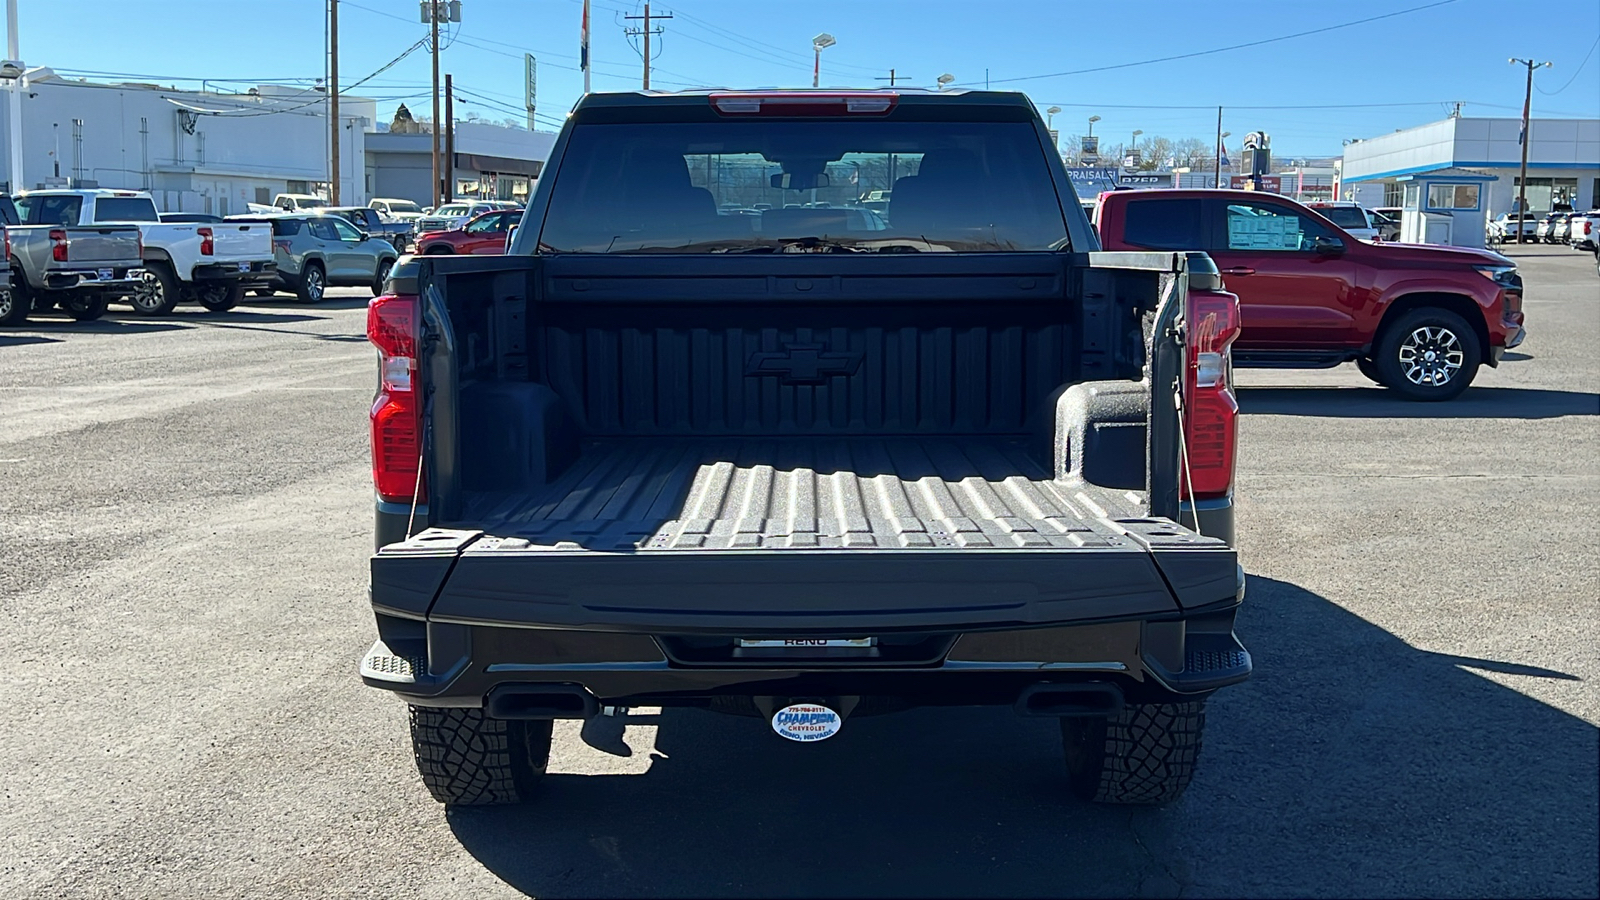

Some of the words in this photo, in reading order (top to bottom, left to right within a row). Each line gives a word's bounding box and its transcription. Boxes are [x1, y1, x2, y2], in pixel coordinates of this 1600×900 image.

[777, 711, 837, 725] CHAMPION
[779, 728, 802, 740] RENO,
[803, 729, 834, 740] NEVADA
